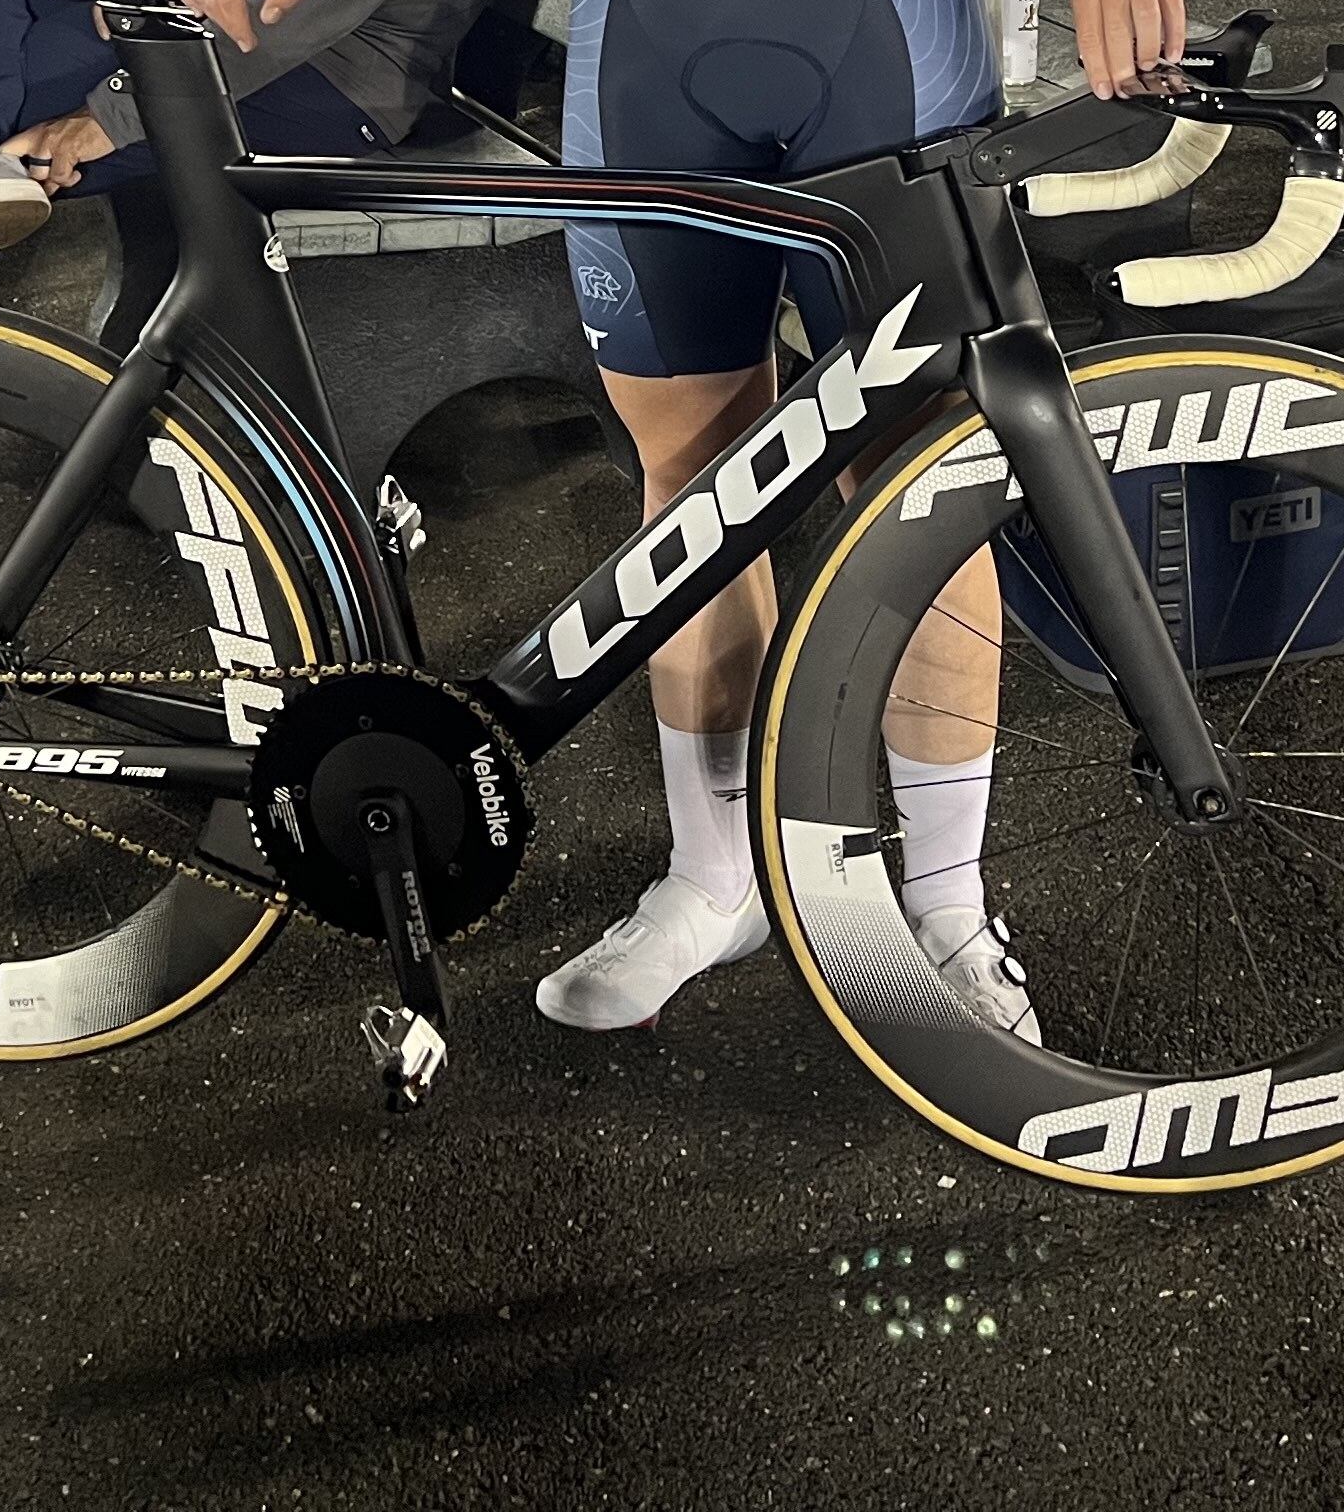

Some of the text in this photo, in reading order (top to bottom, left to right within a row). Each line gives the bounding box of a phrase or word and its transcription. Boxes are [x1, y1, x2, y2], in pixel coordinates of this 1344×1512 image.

[548, 282, 942, 679] LOOK
[1239, 497, 1314, 533] YETI
[470, 743, 510, 847] Velobike
[831, 843, 846, 873] RYOT
